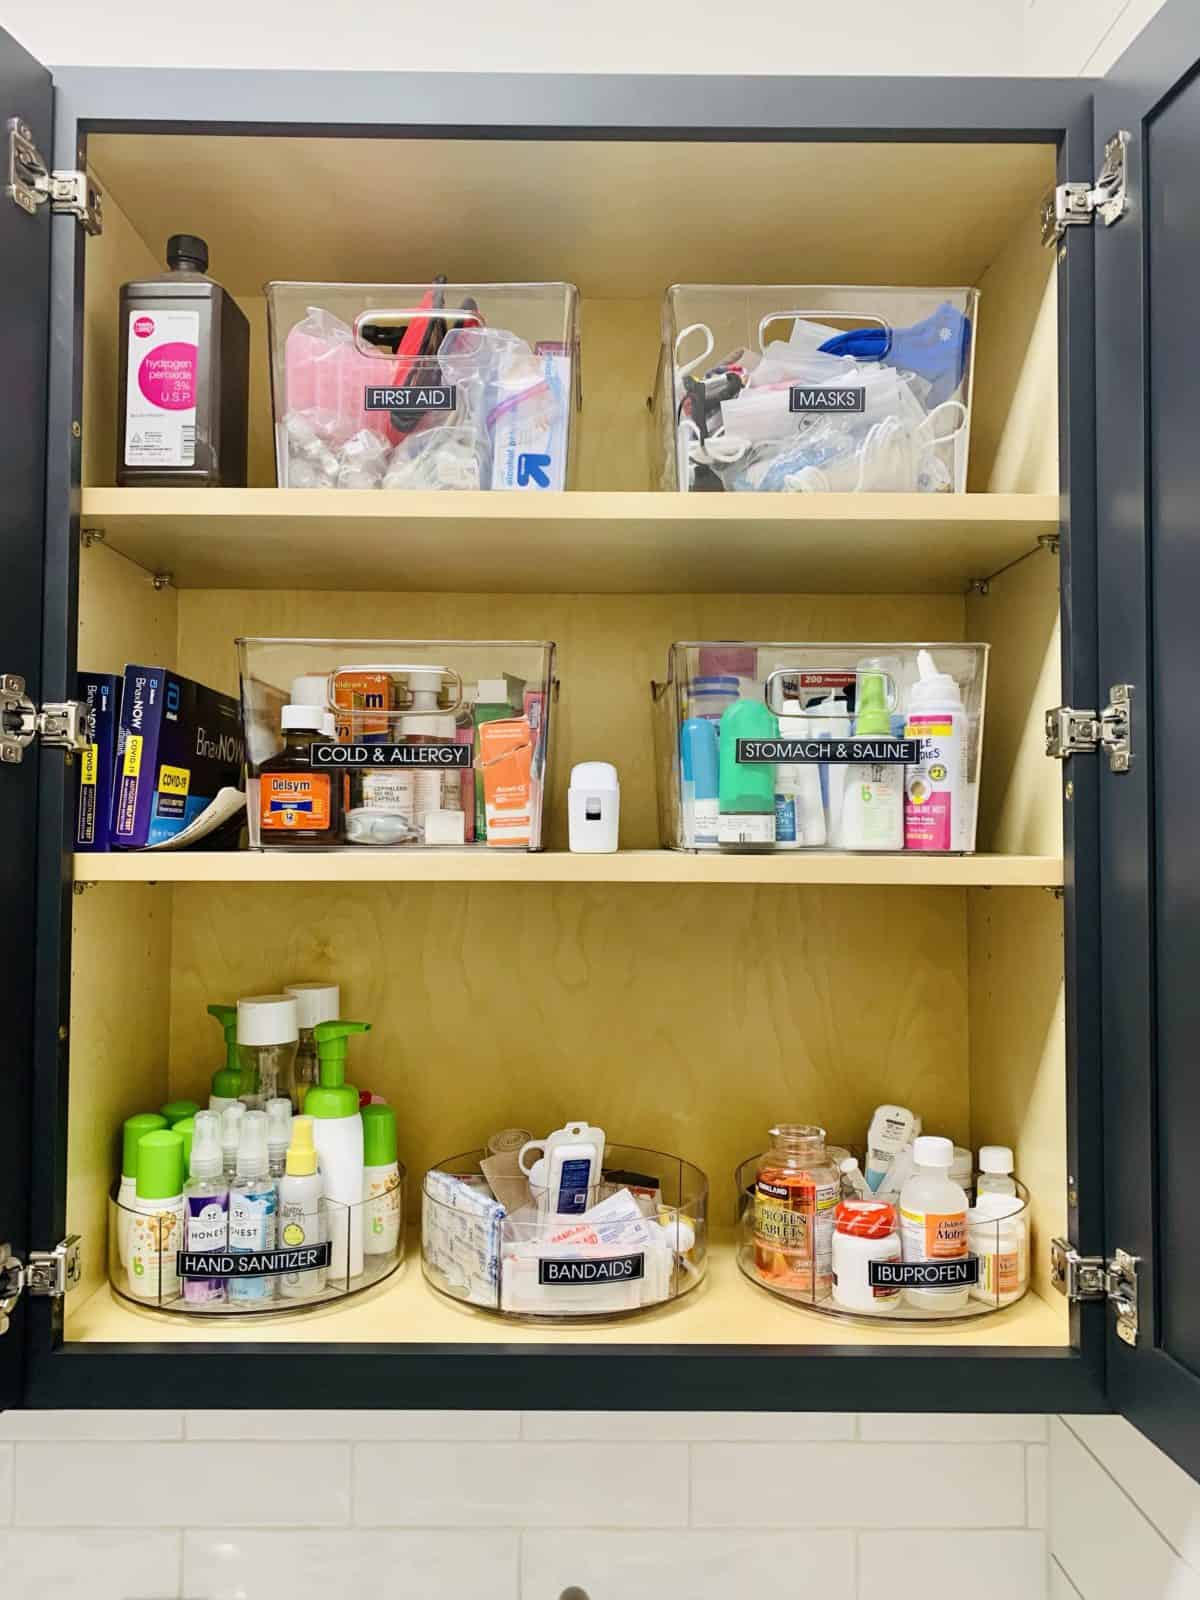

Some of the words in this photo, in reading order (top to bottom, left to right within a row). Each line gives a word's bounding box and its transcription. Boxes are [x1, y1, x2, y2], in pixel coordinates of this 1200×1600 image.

[146, 358, 192, 371] hydrogen
[148, 371, 193, 383] peroxide
[174, 380, 190, 391] 3%
[373, 390, 413, 406] FIRST
[415, 390, 446, 406] AID
[800, 390, 856, 407] MASKS
[128, 739, 138, 773] COVID-19
[317, 747, 368, 762] COLD
[372, 747, 385, 762] &
[390, 747, 464, 763] ALLERGY
[745, 743, 831, 759] STOMACH
[835, 743, 849, 759] &
[853, 743, 910, 759] SALINE
[162, 773, 187, 788] COVID-19
[272, 779, 311, 793] Delsym
[185, 1255, 235, 1273] HAND
[238, 1249, 318, 1272] SANITIZER
[549, 1259, 633, 1280] BANDAIDS
[877, 1263, 968, 1282] IBUPROFEN
